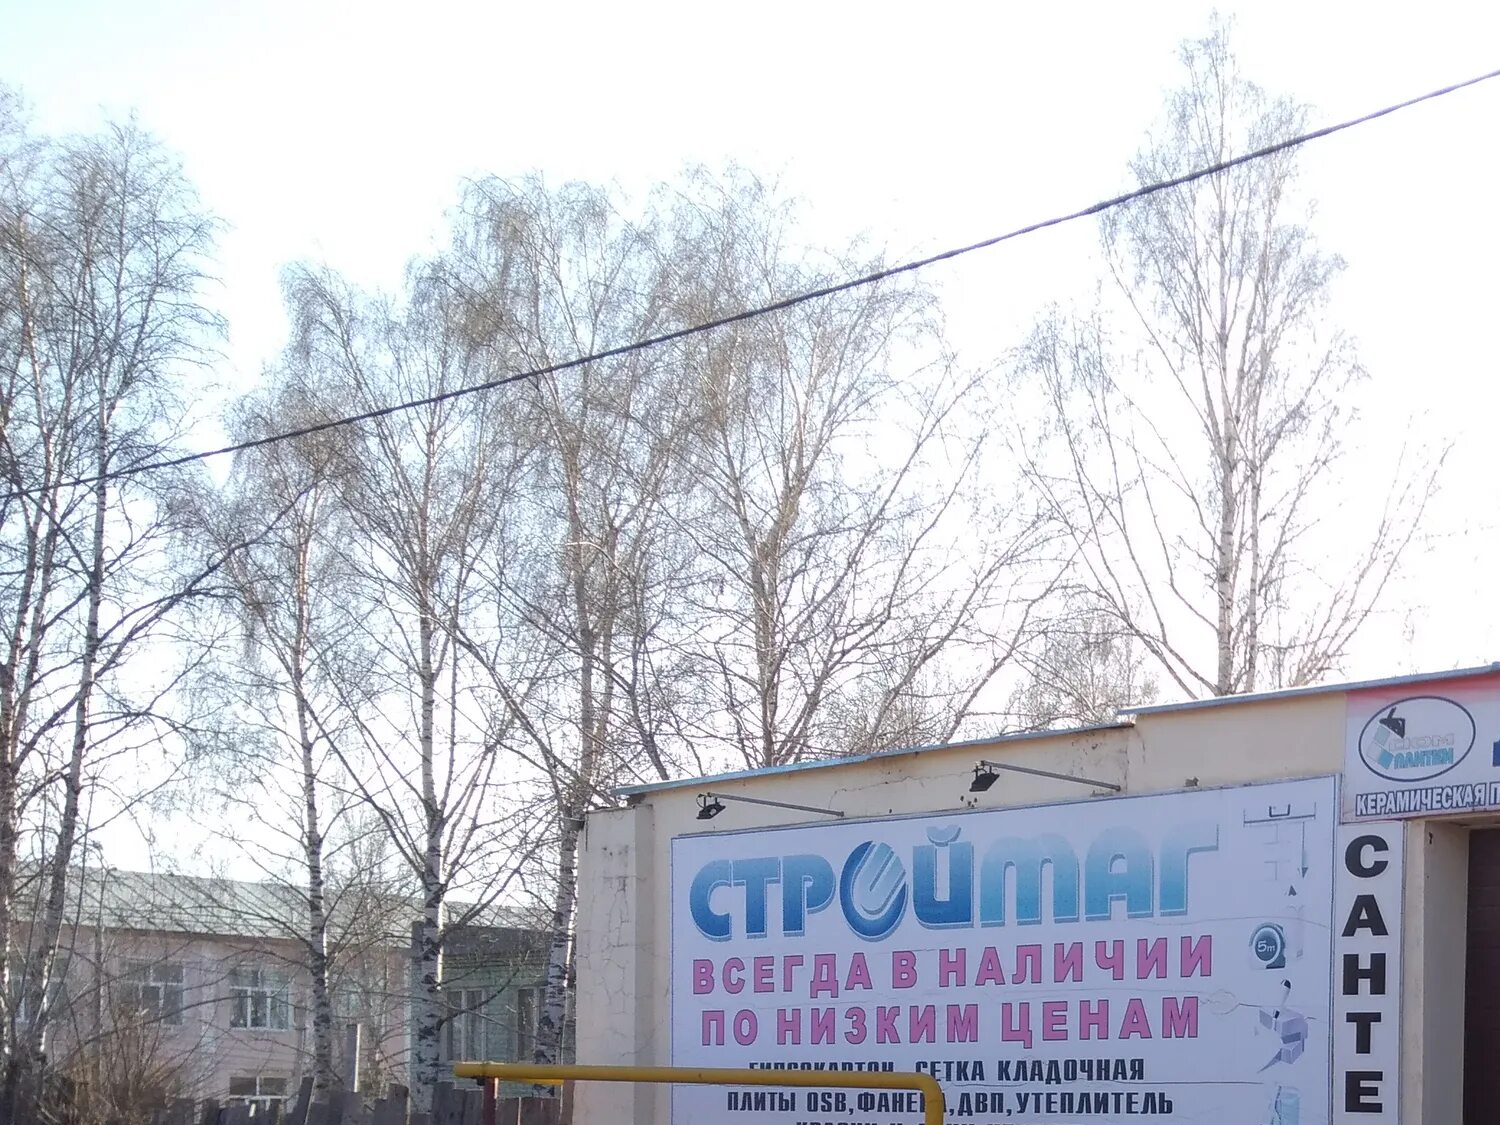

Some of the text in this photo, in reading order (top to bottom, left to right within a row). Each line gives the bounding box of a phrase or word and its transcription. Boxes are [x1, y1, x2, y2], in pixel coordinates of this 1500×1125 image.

[1356, 782, 1487, 816] КЕРАМИЧЕСКАЯ
[689, 823, 1219, 942] СТРОЙМАГ
[692, 934, 1213, 998] ВСЕГДА В НАЛИЧИИ
[700, 995, 1199, 1049] ПО НИЗКИМ ЦЕНАМ
[916, 1061, 985, 1082] СЕТКА
[998, 1058, 1145, 1085] КЛАДОЧНАЯ
[727, 1091, 1174, 1116] ПЛИТЫ OSB,ФАНЕ,ДВП,УТЕПЛИТЕЛЬ
